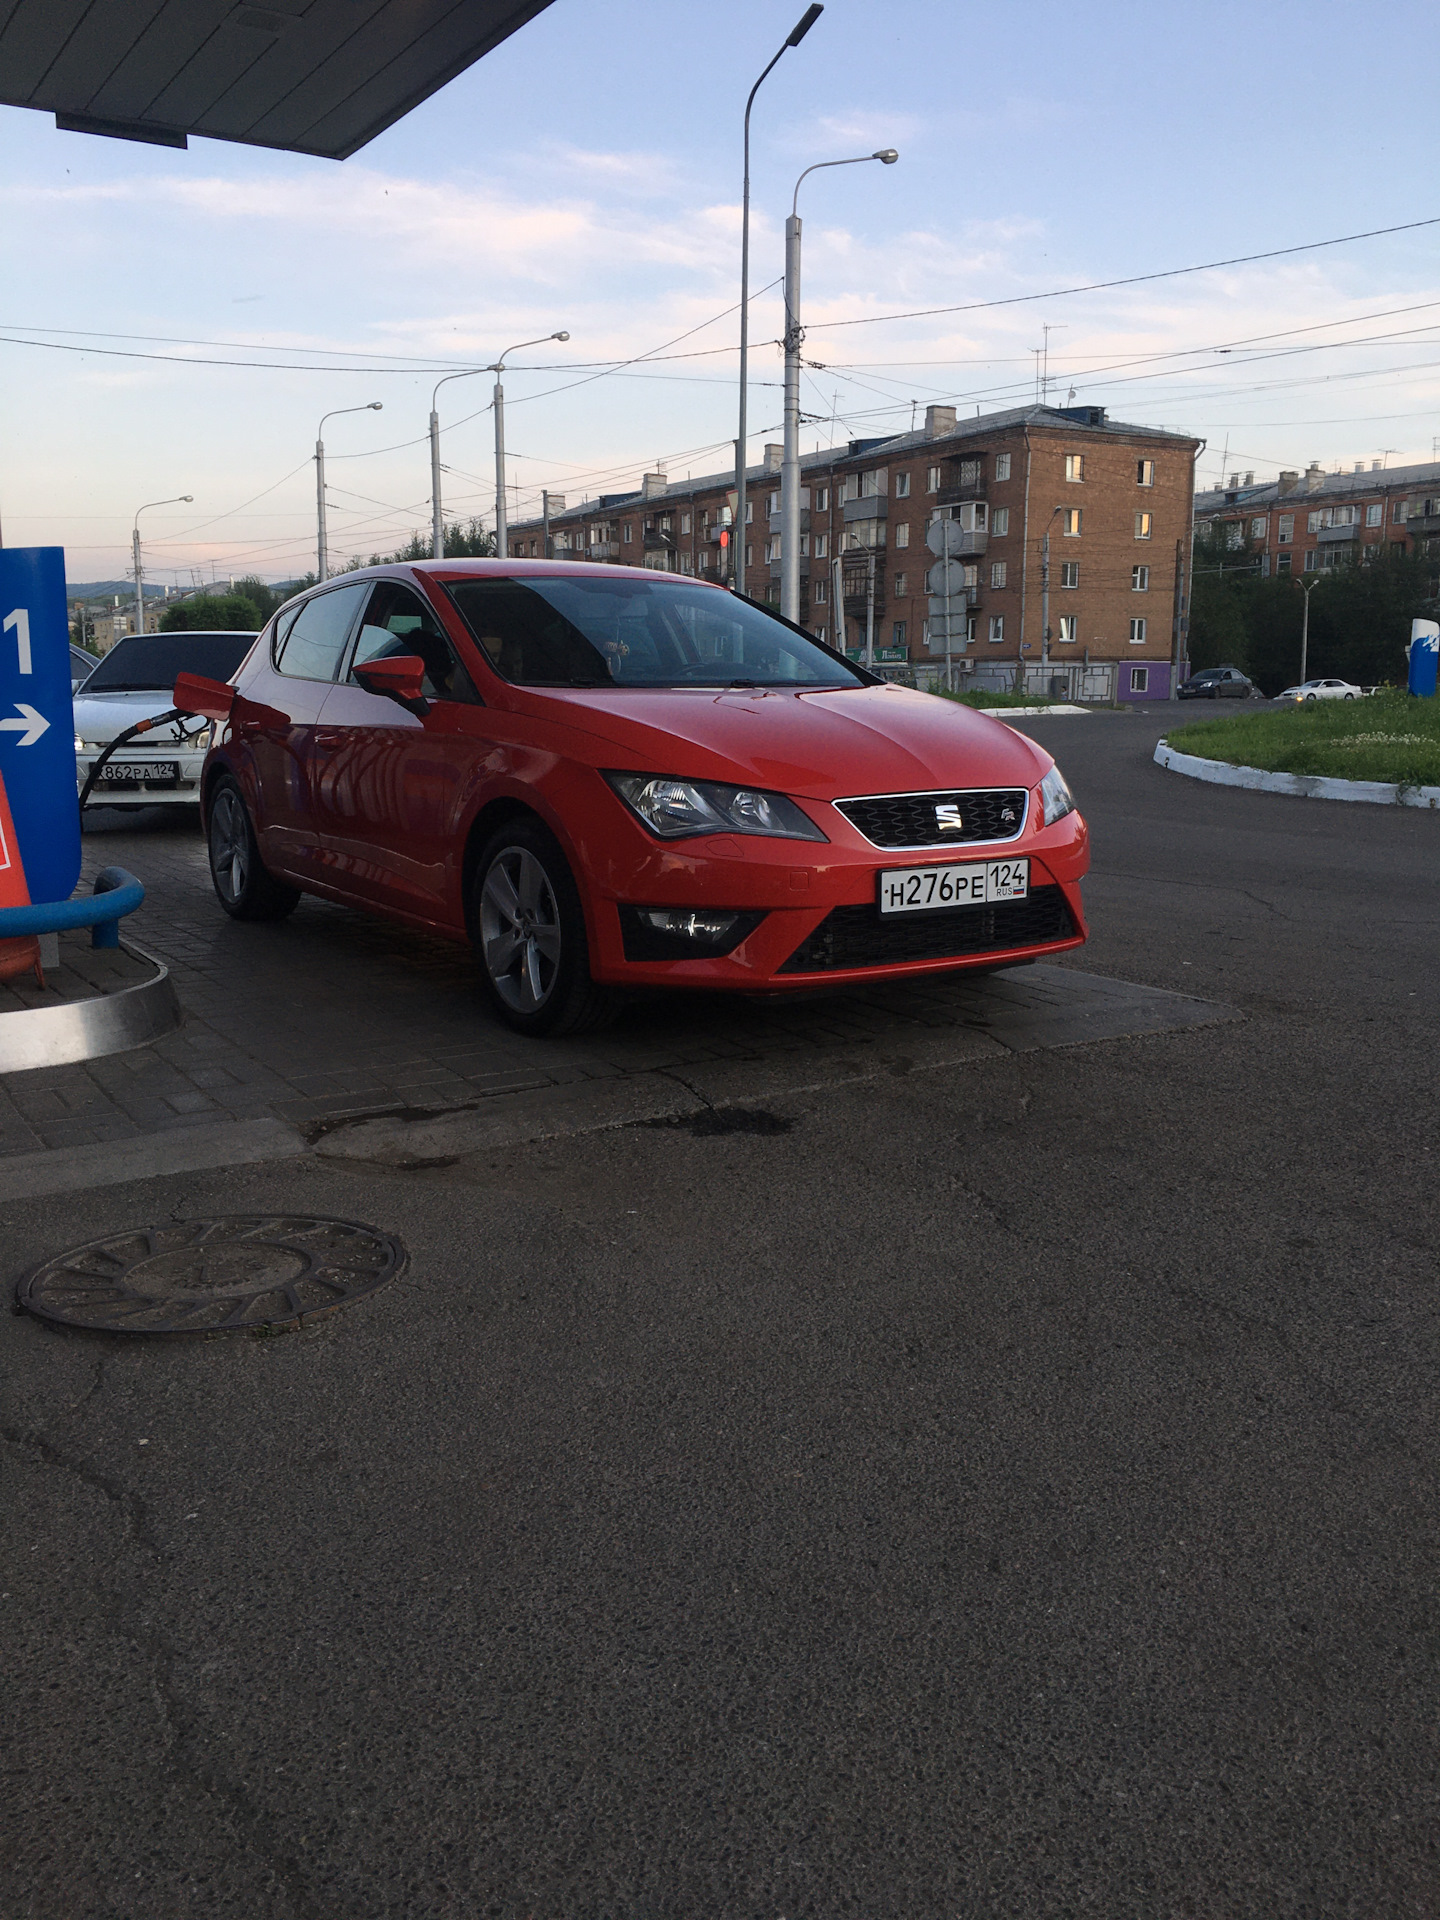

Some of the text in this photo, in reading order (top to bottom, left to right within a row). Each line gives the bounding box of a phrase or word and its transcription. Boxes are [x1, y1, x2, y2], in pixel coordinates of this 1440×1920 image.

[3, 608, 33, 675] 1
[890, 863, 1024, 907] Н276РЕ 124
[996, 887, 1012, 897] RUS
